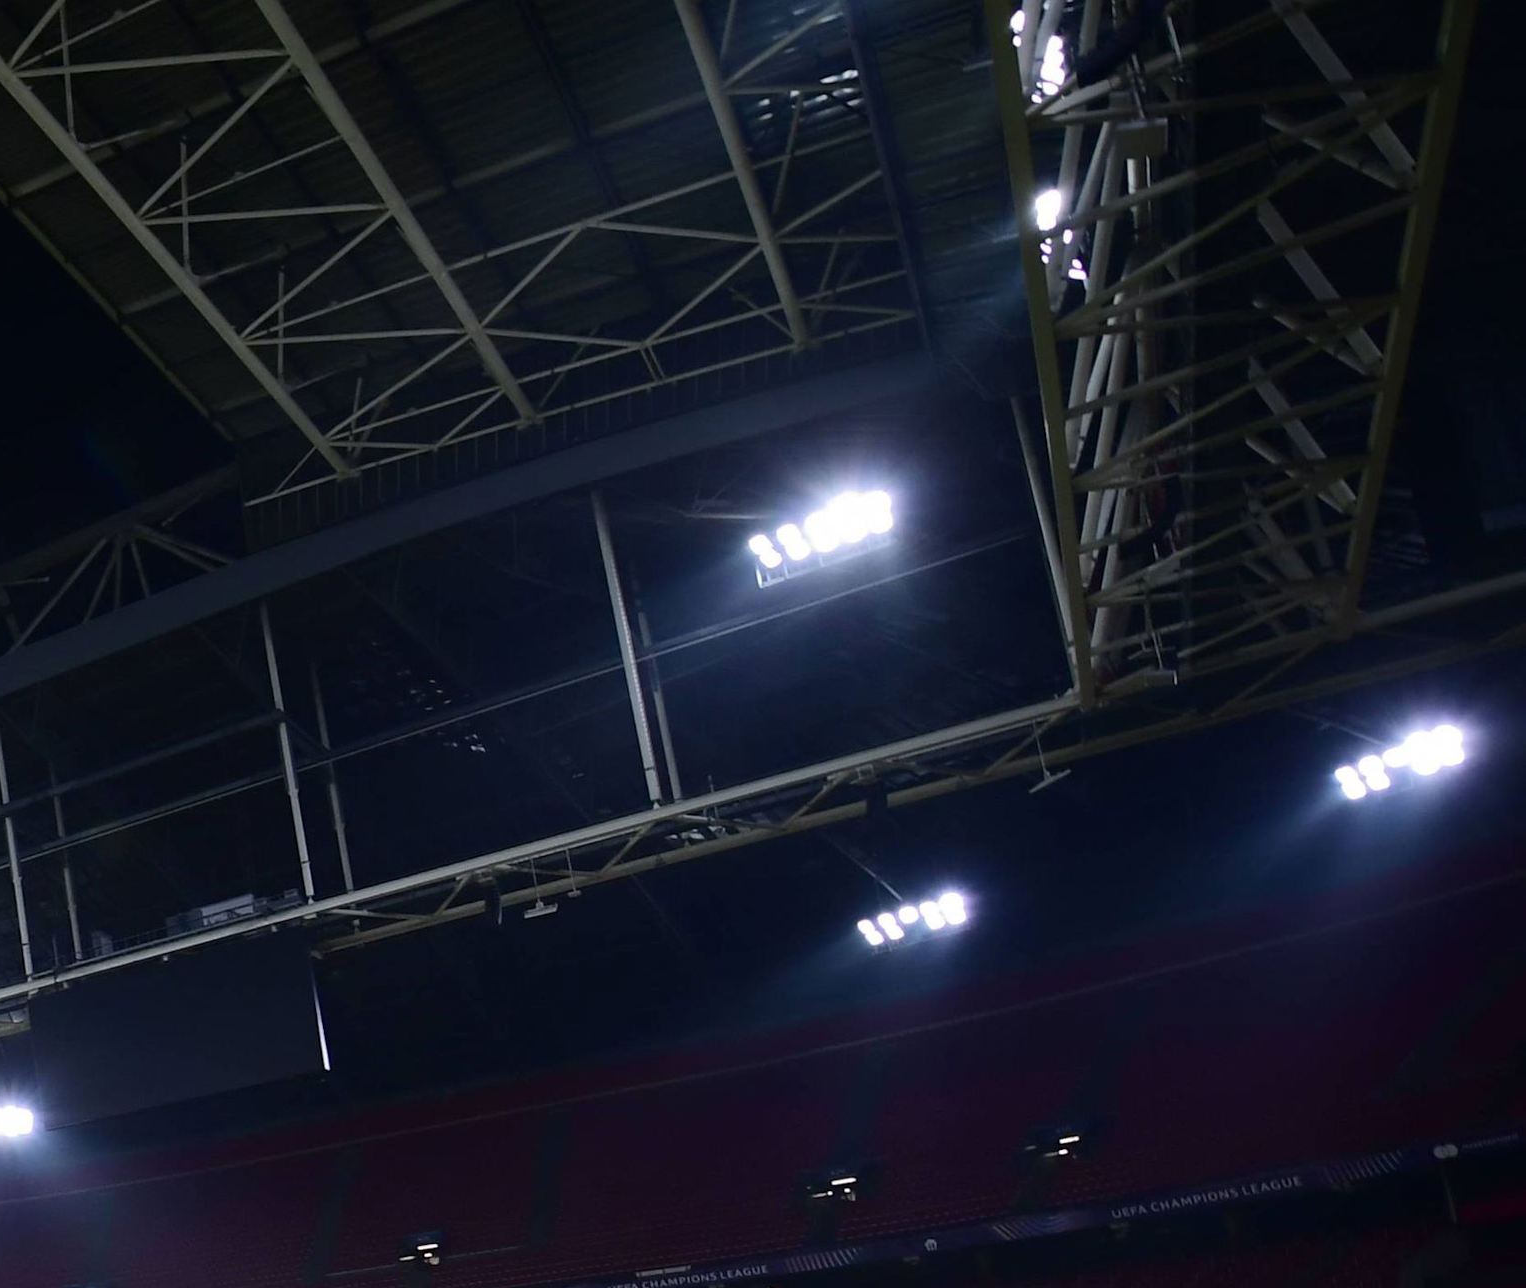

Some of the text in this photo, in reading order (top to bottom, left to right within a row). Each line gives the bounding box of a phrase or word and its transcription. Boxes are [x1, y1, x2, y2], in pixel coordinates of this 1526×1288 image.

[1111, 1175, 1302, 1219] UEFA CHAMPIONS LEAGUE
[718, 1265, 768, 1280] LEAGUE
